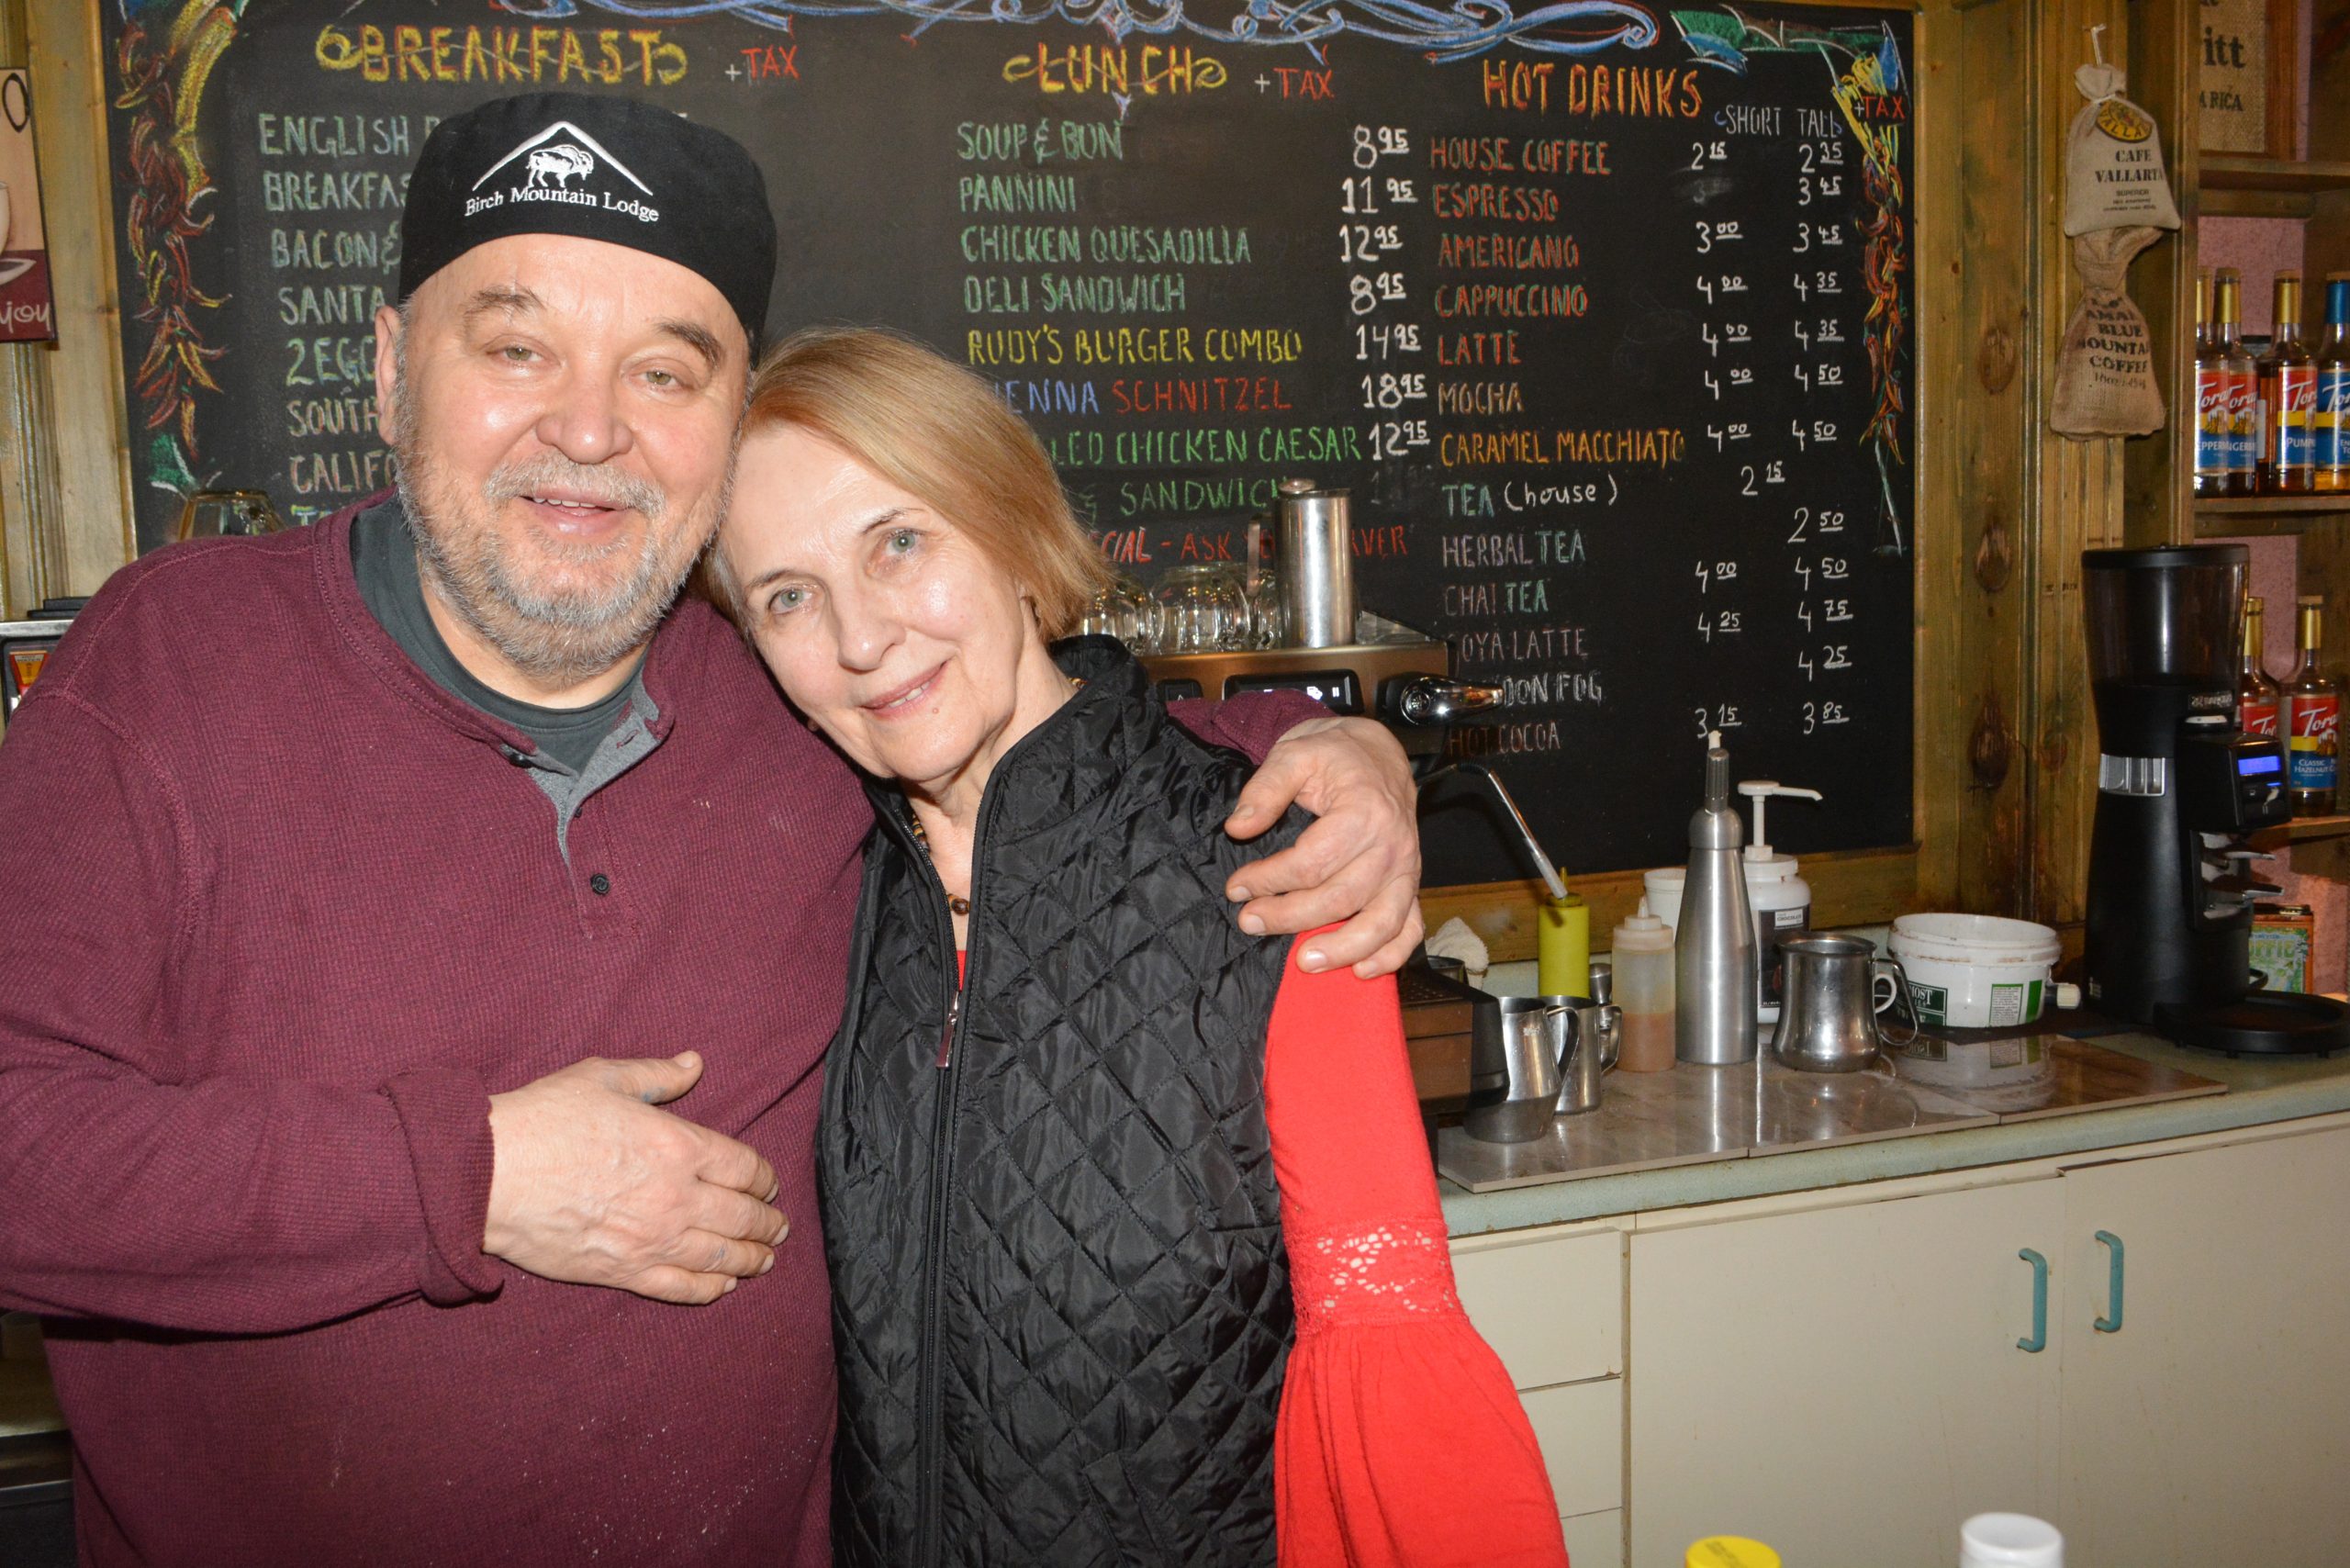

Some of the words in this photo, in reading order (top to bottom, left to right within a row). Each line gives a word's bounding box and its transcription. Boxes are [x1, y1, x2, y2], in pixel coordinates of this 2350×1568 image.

[2203, 26, 2246, 69] itt
[1037, 42, 1193, 94] LUNCH
[1482, 58, 1554, 111] HOT
[1568, 63, 1704, 120] DRINKS
[258, 113, 410, 158] ENGLISH
[1725, 104, 1782, 137] SHORT
[956, 120, 1027, 162] SOUP
[1060, 120, 1125, 162] BUN
[1429, 136, 1515, 173] HOUSE
[1523, 139, 1613, 175] COFFEE
[464, 190, 504, 217] Birch
[509, 185, 598, 207] Mountain
[602, 192, 660, 223] Lodge
[959, 174, 1077, 213] PANNINI
[1432, 183, 1559, 222] ESPRESSO
[960, 225, 1082, 263] CHICKEN
[1091, 224, 1252, 264] QUESADILLA
[1438, 231, 1580, 270] AMERICANO
[964, 274, 1030, 313] DELI
[1041, 273, 1186, 313] SANDWICH
[1435, 283, 1589, 318] CAPPUCCINO
[968, 323, 1064, 365] RUDY'S
[1074, 327, 1194, 365] BURGER
[1205, 328, 1303, 363] COMBO
[1437, 329, 1522, 366] LATTE
[1111, 377, 1293, 416] SCHNITZEL
[1438, 381, 1525, 415] MOCHA
[1116, 428, 1247, 466] CHICKEN
[1259, 424, 1362, 464] CAESAR
[1439, 430, 1549, 467] CARAMEL
[1556, 428, 1686, 469] MACCHIATO
[1441, 483, 1495, 518] TEA
[1180, 531, 1233, 563] ASK
[1441, 532, 1534, 570] HERBAL
[1534, 527, 1586, 566] TEA
[1444, 581, 1498, 617] CHAI
[1505, 578, 1550, 615] TEA
[1448, 632, 1505, 664] OYA
[1513, 627, 1590, 661] LATTE
[1555, 670, 1603, 707] FOG
[1498, 719, 1561, 756] COCOA
